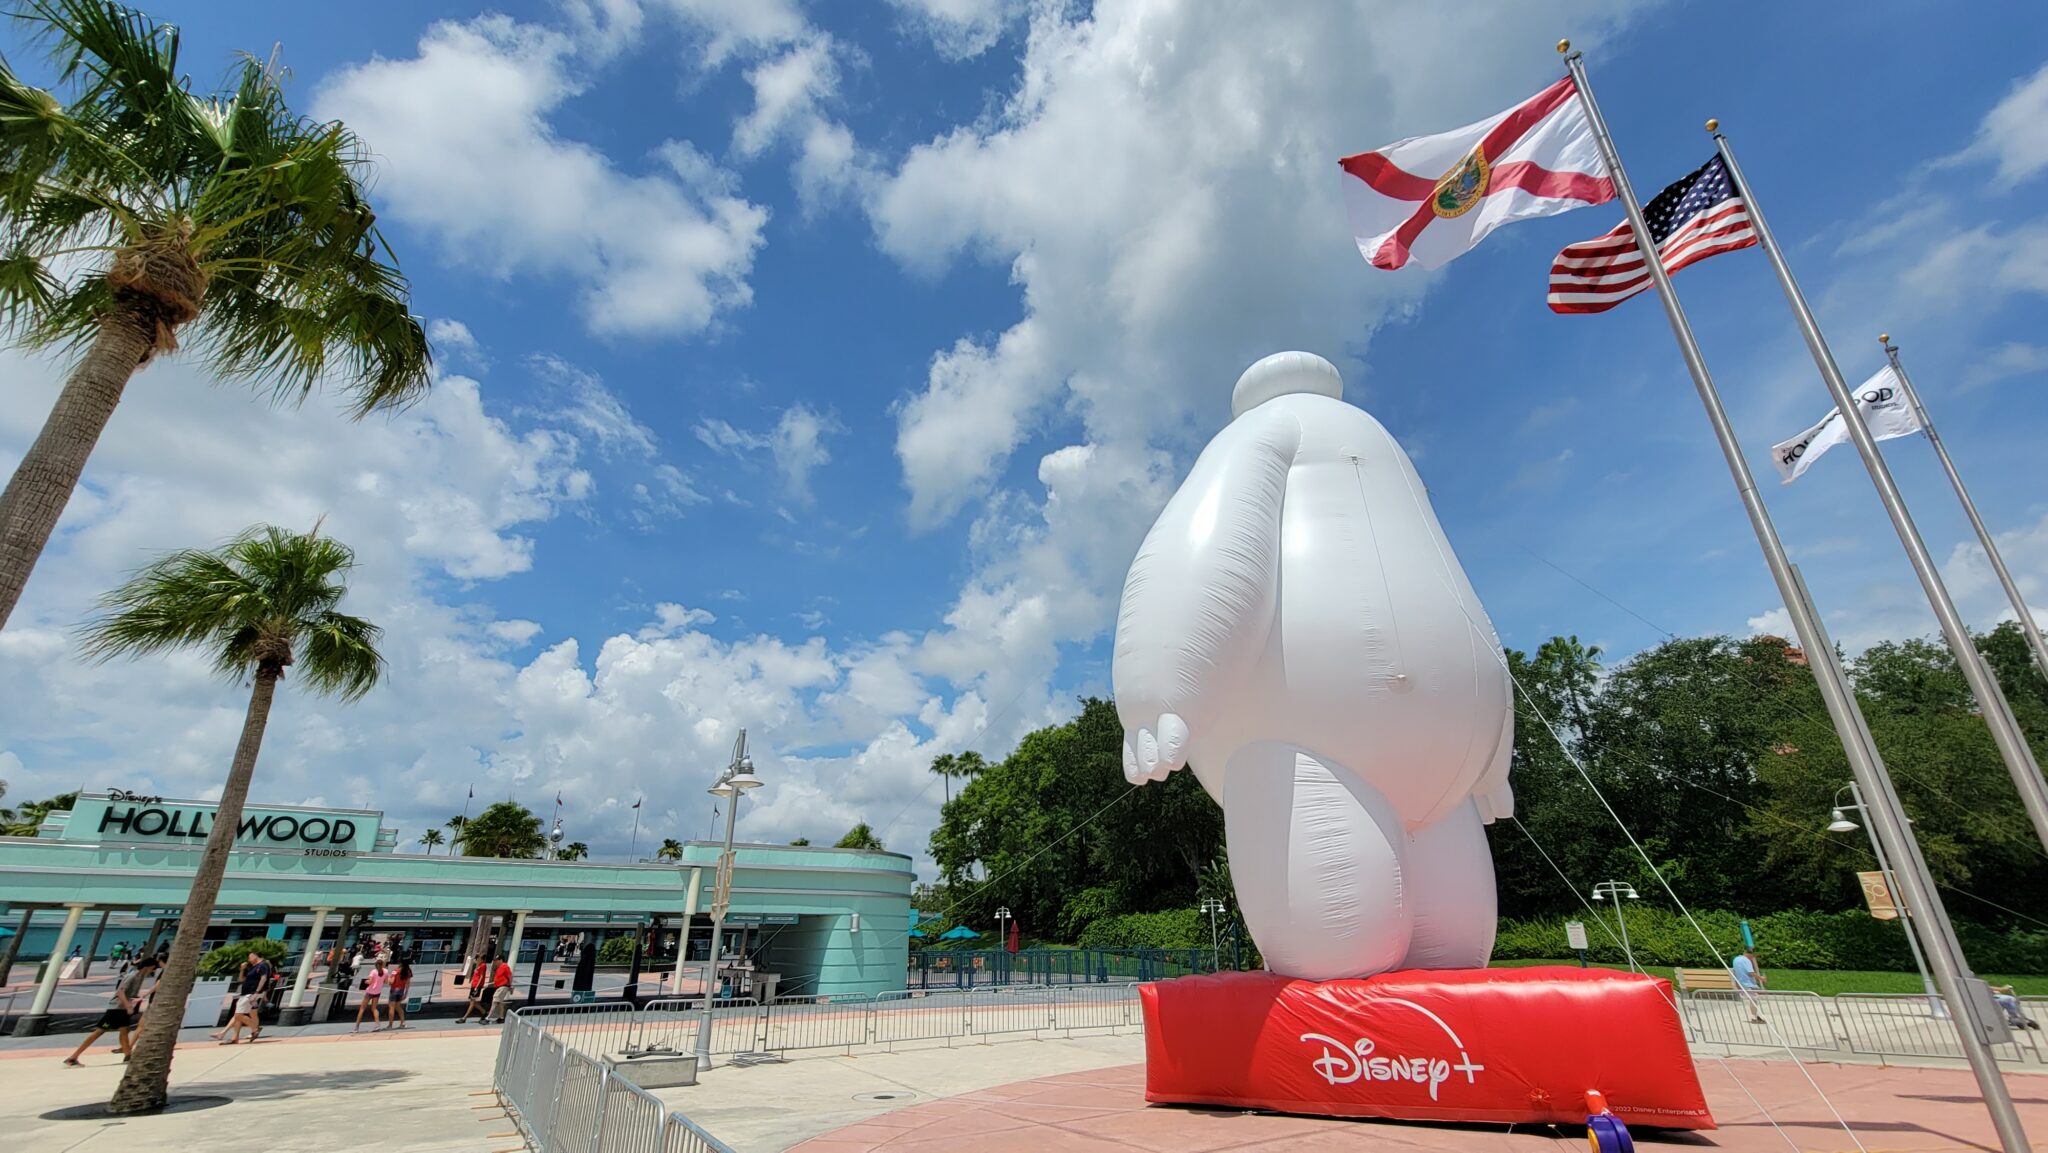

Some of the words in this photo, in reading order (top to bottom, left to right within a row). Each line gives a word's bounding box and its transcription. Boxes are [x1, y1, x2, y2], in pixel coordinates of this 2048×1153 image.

[98, 806, 356, 844] HOLLWOOD
[304, 847, 347, 857] STUDIOS
[1633, 1106, 1656, 1114] Disney
